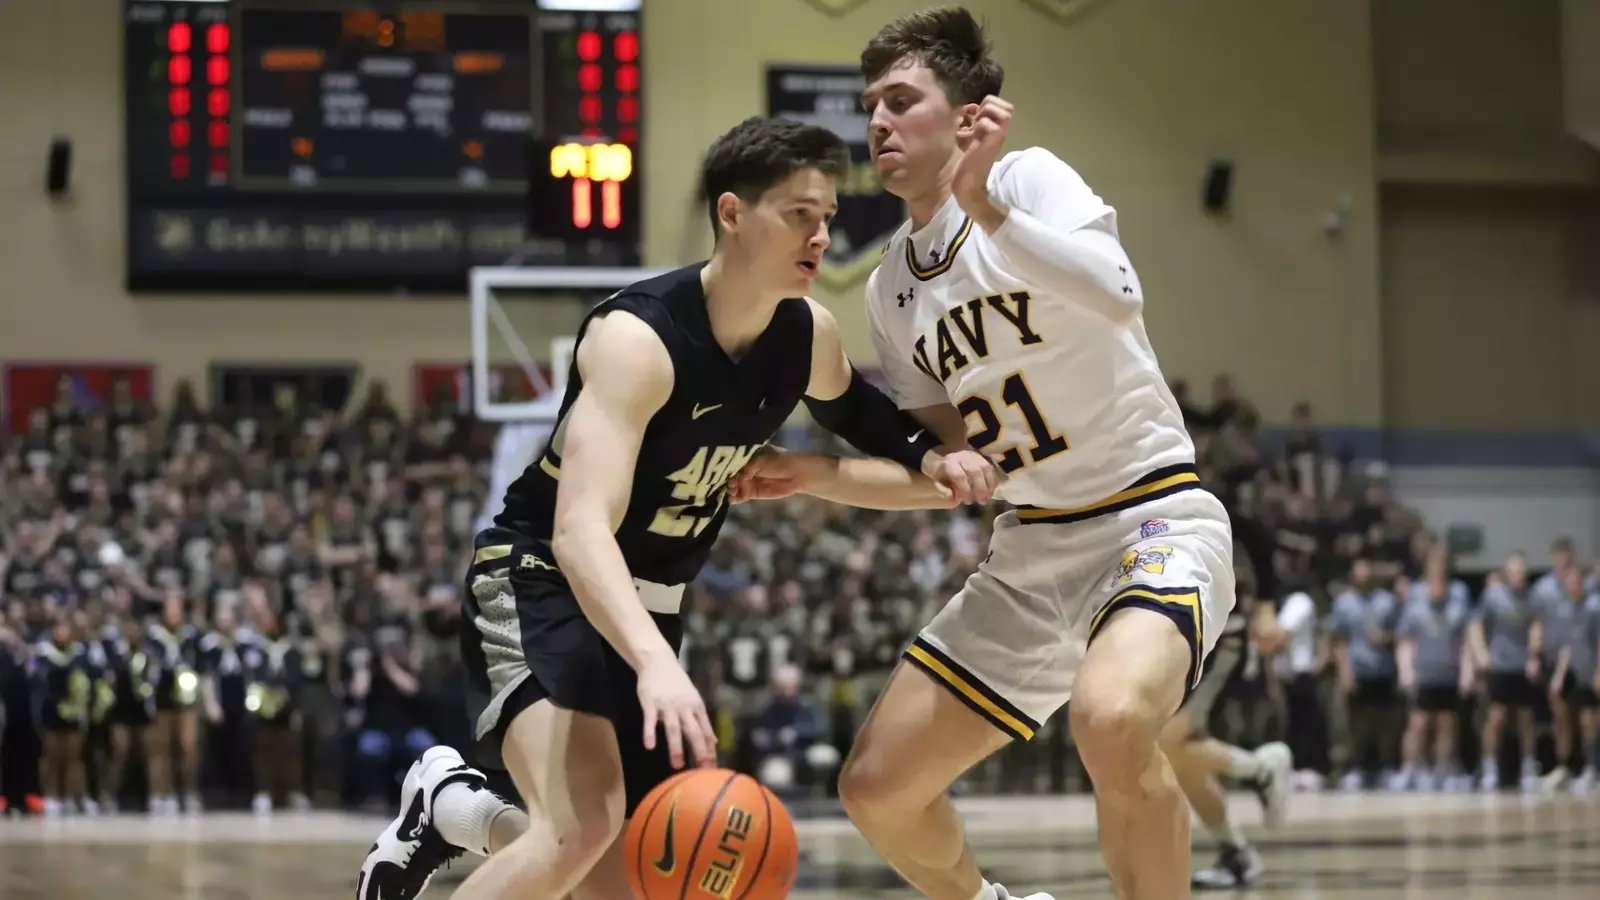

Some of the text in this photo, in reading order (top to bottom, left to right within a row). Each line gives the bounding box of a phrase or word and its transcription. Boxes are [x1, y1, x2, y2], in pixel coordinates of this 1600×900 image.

[912, 290, 1045, 389] NAVY
[956, 369, 1071, 475] 21
[665, 443, 768, 507] ARM
[700, 805, 754, 897] ELITE
